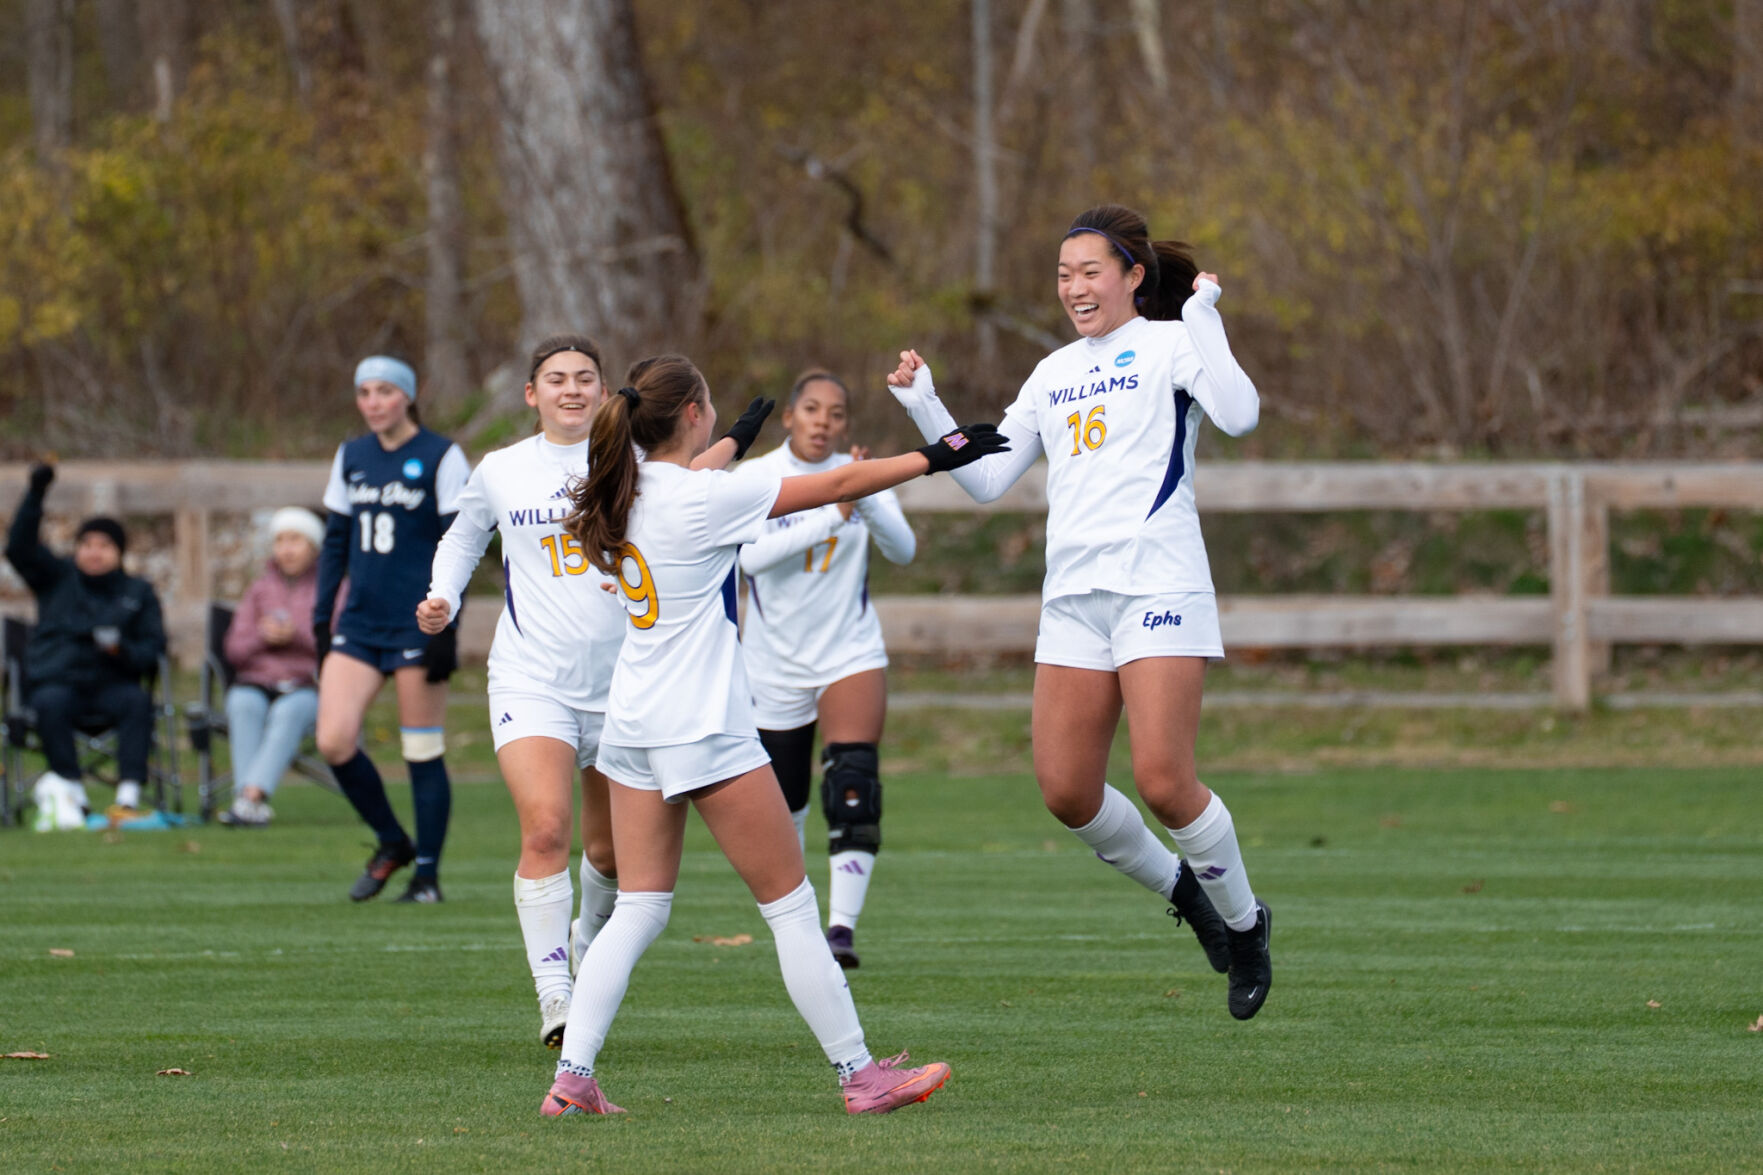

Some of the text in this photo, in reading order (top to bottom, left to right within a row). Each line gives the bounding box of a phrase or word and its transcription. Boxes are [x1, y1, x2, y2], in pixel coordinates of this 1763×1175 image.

[1049, 374, 1139, 408] WILLIAMS
[1067, 404, 1107, 457] 16
[359, 511, 395, 554] 18
[509, 508, 566, 526] WILLI
[540, 533, 590, 578] 15
[804, 536, 838, 573] 17
[616, 541, 660, 630] 9
[1143, 610, 1182, 631] Ephs
